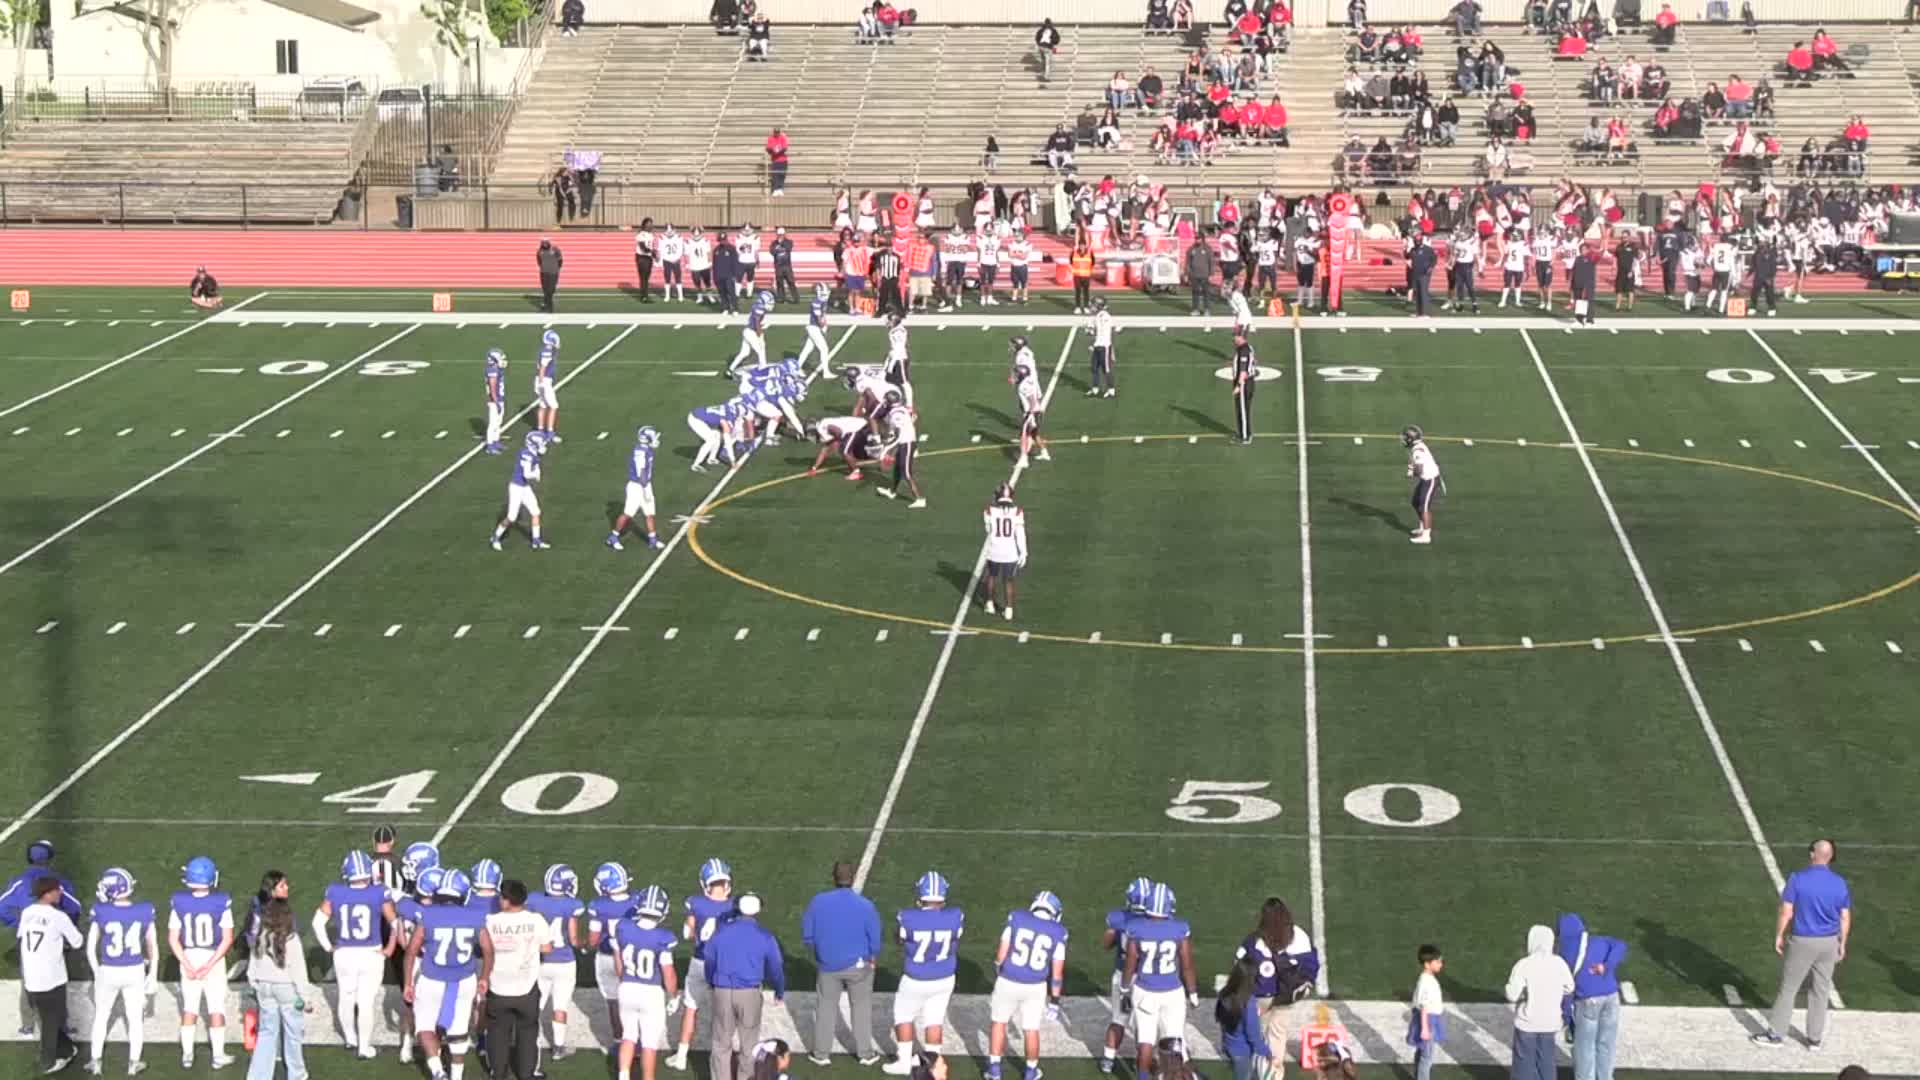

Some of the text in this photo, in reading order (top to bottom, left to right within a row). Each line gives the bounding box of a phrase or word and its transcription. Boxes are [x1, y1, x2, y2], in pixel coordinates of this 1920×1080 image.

[995, 517, 1012, 538] 10
[104, 921, 142, 957] 34
[183, 912, 214, 947] 10
[340, 903, 371, 940] 13
[26, 930, 45, 952] 17
[432, 927, 475, 966] 75
[912, 929, 952, 963] 77
[1011, 927, 1053, 971] 56
[1140, 940, 1177, 974] 72
[622, 943, 655, 979] 40
